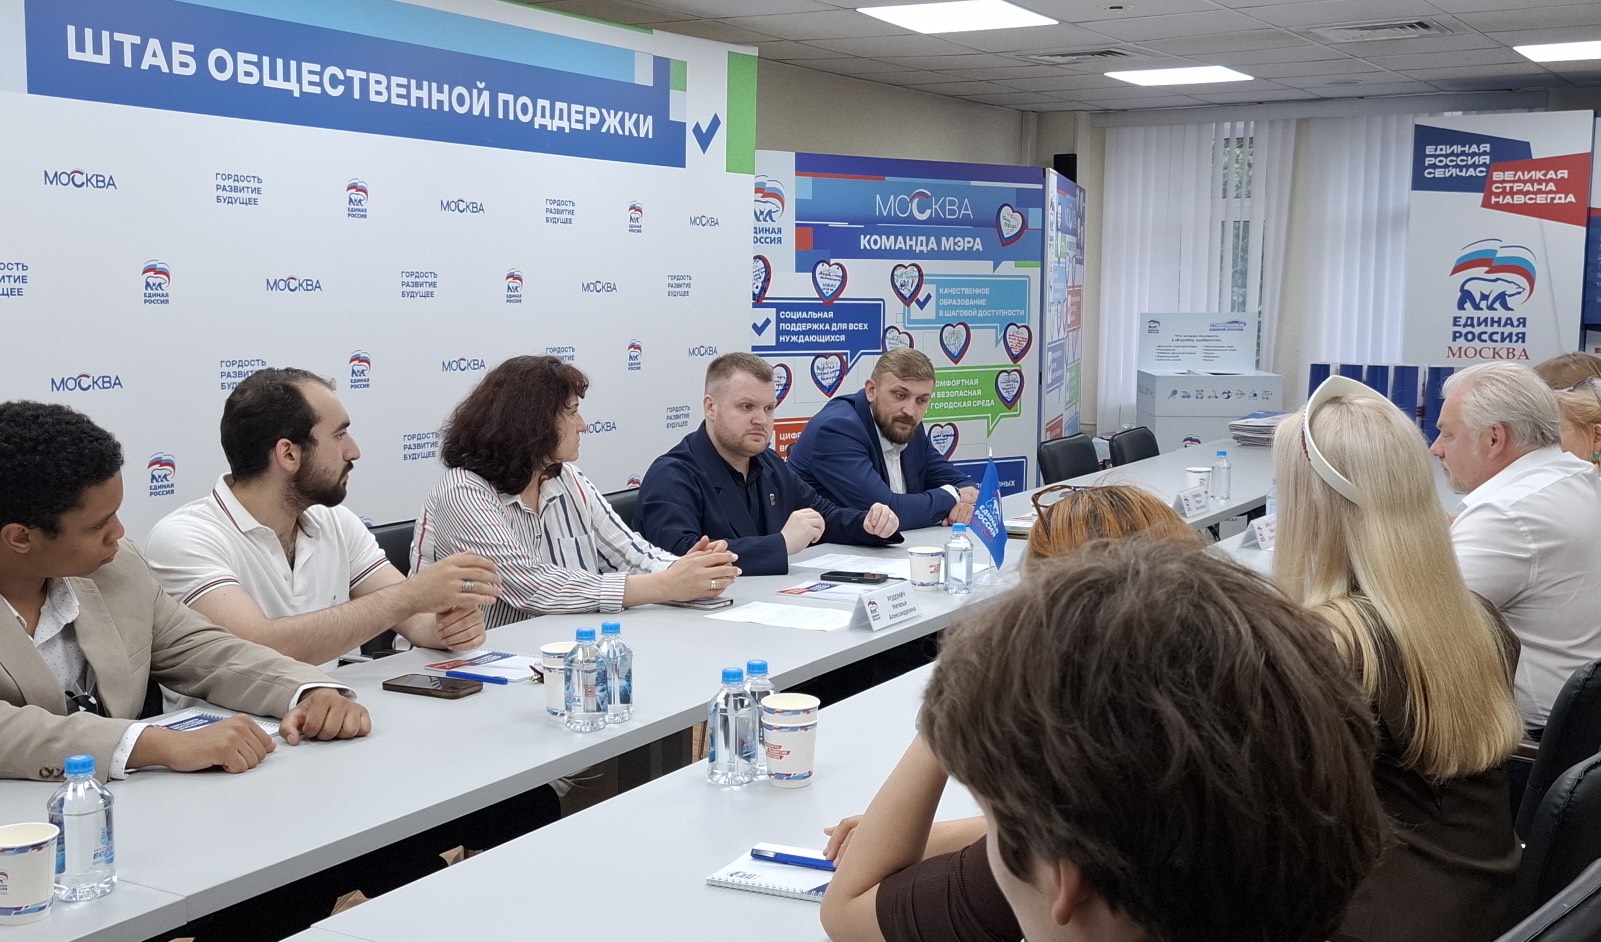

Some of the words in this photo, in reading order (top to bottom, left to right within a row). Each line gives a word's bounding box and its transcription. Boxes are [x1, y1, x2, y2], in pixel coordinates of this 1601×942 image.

[67, 25, 197, 76] ШТАБ
[208, 48, 490, 117] ОБЩЕСТВЕННОЙ
[498, 92, 653, 139] ПОДДЕРЖКИ
[1425, 143, 1490, 155] ЕДИНАЯ
[1424, 155, 1490, 167] РОССИЯ
[215, 172, 263, 184] ГОРДОСТЬ
[1424, 167, 1487, 178] СЕЙЧАС
[1492, 170, 1568, 181] ВЕЛИКАЯ
[44, 168, 117, 190] МОСКВА
[216, 184, 262, 195] РАЗВИТИЕ
[1491, 181, 1556, 192] СТРАНА
[216, 195, 259, 206] БУДУЩЕЕ
[545, 198, 575, 207] ГОРДОСТЬ
[875, 188, 973, 220] МОСКВА
[1491, 193, 1576, 205] НАВСЕГДА
[440, 198, 485, 214] МОСКВА
[545, 207, 575, 216] РАЗВИТИЕ
[545, 216, 573, 225] БУДУЩЕЕ
[690, 215, 720, 227] МОСКВА
[753, 226, 782, 235] ДИНАЯ
[753, 236, 782, 245] ОССИЯ
[860, 234, 936, 253] КОМАНДА
[941, 237, 983, 252] МЭРА
[401, 270, 438, 280] ГОРДОСТЬ
[667, 274, 692, 282] ГОРДОСТЬ
[266, 276, 322, 293] МОСКВА
[401, 280, 438, 289] РАЗВИТИЕ
[581, 280, 618, 293] МОСКВА
[401, 290, 435, 299] БУДУЩЕЕ
[939, 287, 990, 295] КАЧЕСТВЕННОЕ
[939, 298, 987, 306] ОБРАЗОВАНИЕ
[779, 311, 834, 320] СОЦИАЛЬНАЯ
[944, 308, 977, 317] ШАГОВОЙ
[978, 309, 1025, 318] ДОСТУПНОСТИ
[779, 322, 830, 332] ПОДДЕРЖКА
[831, 322, 847, 332] ДЛЯ
[848, 323, 869, 331] ВСЕХ
[1452, 316, 1527, 328] ЕДИНАЯ
[779, 334, 846, 343] НУЖДАЮЩИХСЯ
[1452, 330, 1526, 344] РОССИЯ
[545, 346, 575, 354] ГОРДОСТЬ
[688, 345, 718, 357] МОСКВА
[1446, 345, 1530, 361] МОСКВА
[220, 358, 267, 368] ГОРДОСТЬ
[442, 357, 486, 372] МОСКВА
[51, 374, 123, 392] МОСКВА
[935, 378, 979, 387] ОМФОРТНАЯ
[937, 389, 982, 398] БЕЗОПАСНАЯ
[666, 405, 691, 413] ГОРДОСТЬ
[930, 400, 971, 410] ГОРОДСКАЯ
[972, 399, 995, 408] СРЕДА
[666, 413, 690, 421] РАЗВИТИЕ
[666, 420, 688, 429] БУДУЩЕЕ
[403, 431, 440, 441] ГОРДОСТЬ
[403, 440, 439, 451] РАЗВИТИЕ
[403, 450, 436, 461] БУДУЩЕЕ
[149, 482, 175, 491] ЕДИНАЯ
[149, 489, 175, 497] РОССИЯ
[974, 509, 997, 538] РОССИЯ
[979, 504, 999, 534] ЕДИНАЯ
